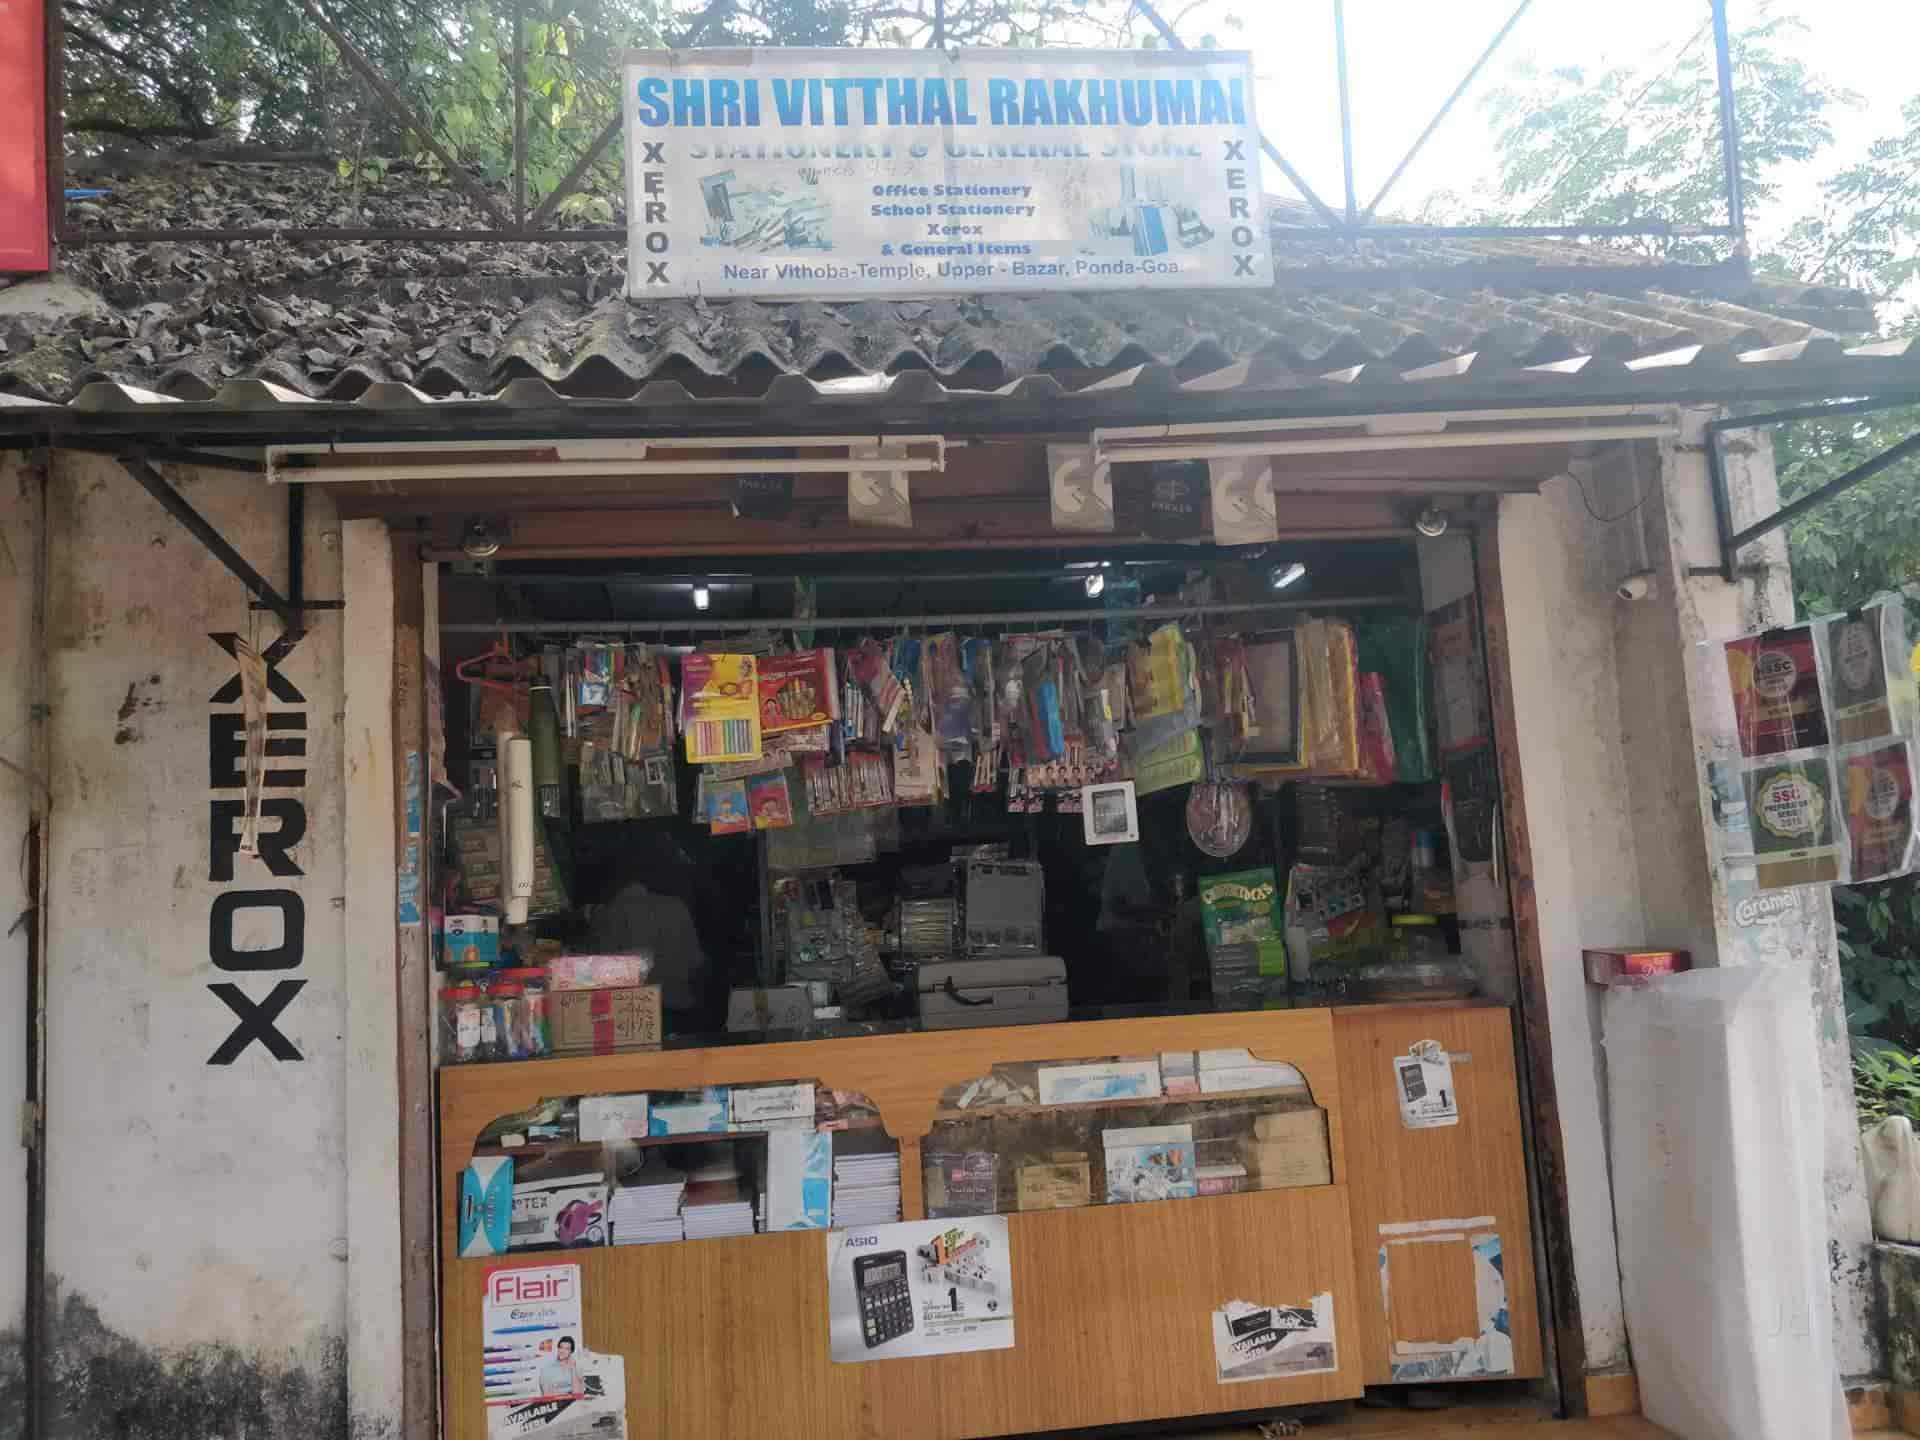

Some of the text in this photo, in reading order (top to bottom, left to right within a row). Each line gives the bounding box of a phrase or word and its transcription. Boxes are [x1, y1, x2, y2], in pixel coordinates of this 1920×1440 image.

[637, 77, 1247, 127] SHRI VITTHAL RAKHUMAI
[872, 184, 1033, 198] Office Stationery
[642, 142, 671, 284] XEROX
[871, 203, 1036, 217] School Stationery
[1223, 139, 1255, 277] XEROX
[927, 222, 983, 236] Xerox
[881, 241, 1032, 257] & General Items
[723, 263, 769, 279] Near
[937, 261, 995, 279] Upper
[206, 630, 308, 1066] XEROX
[845, 1235, 878, 1248] ASIO
[495, 1274, 569, 1303] Flair
